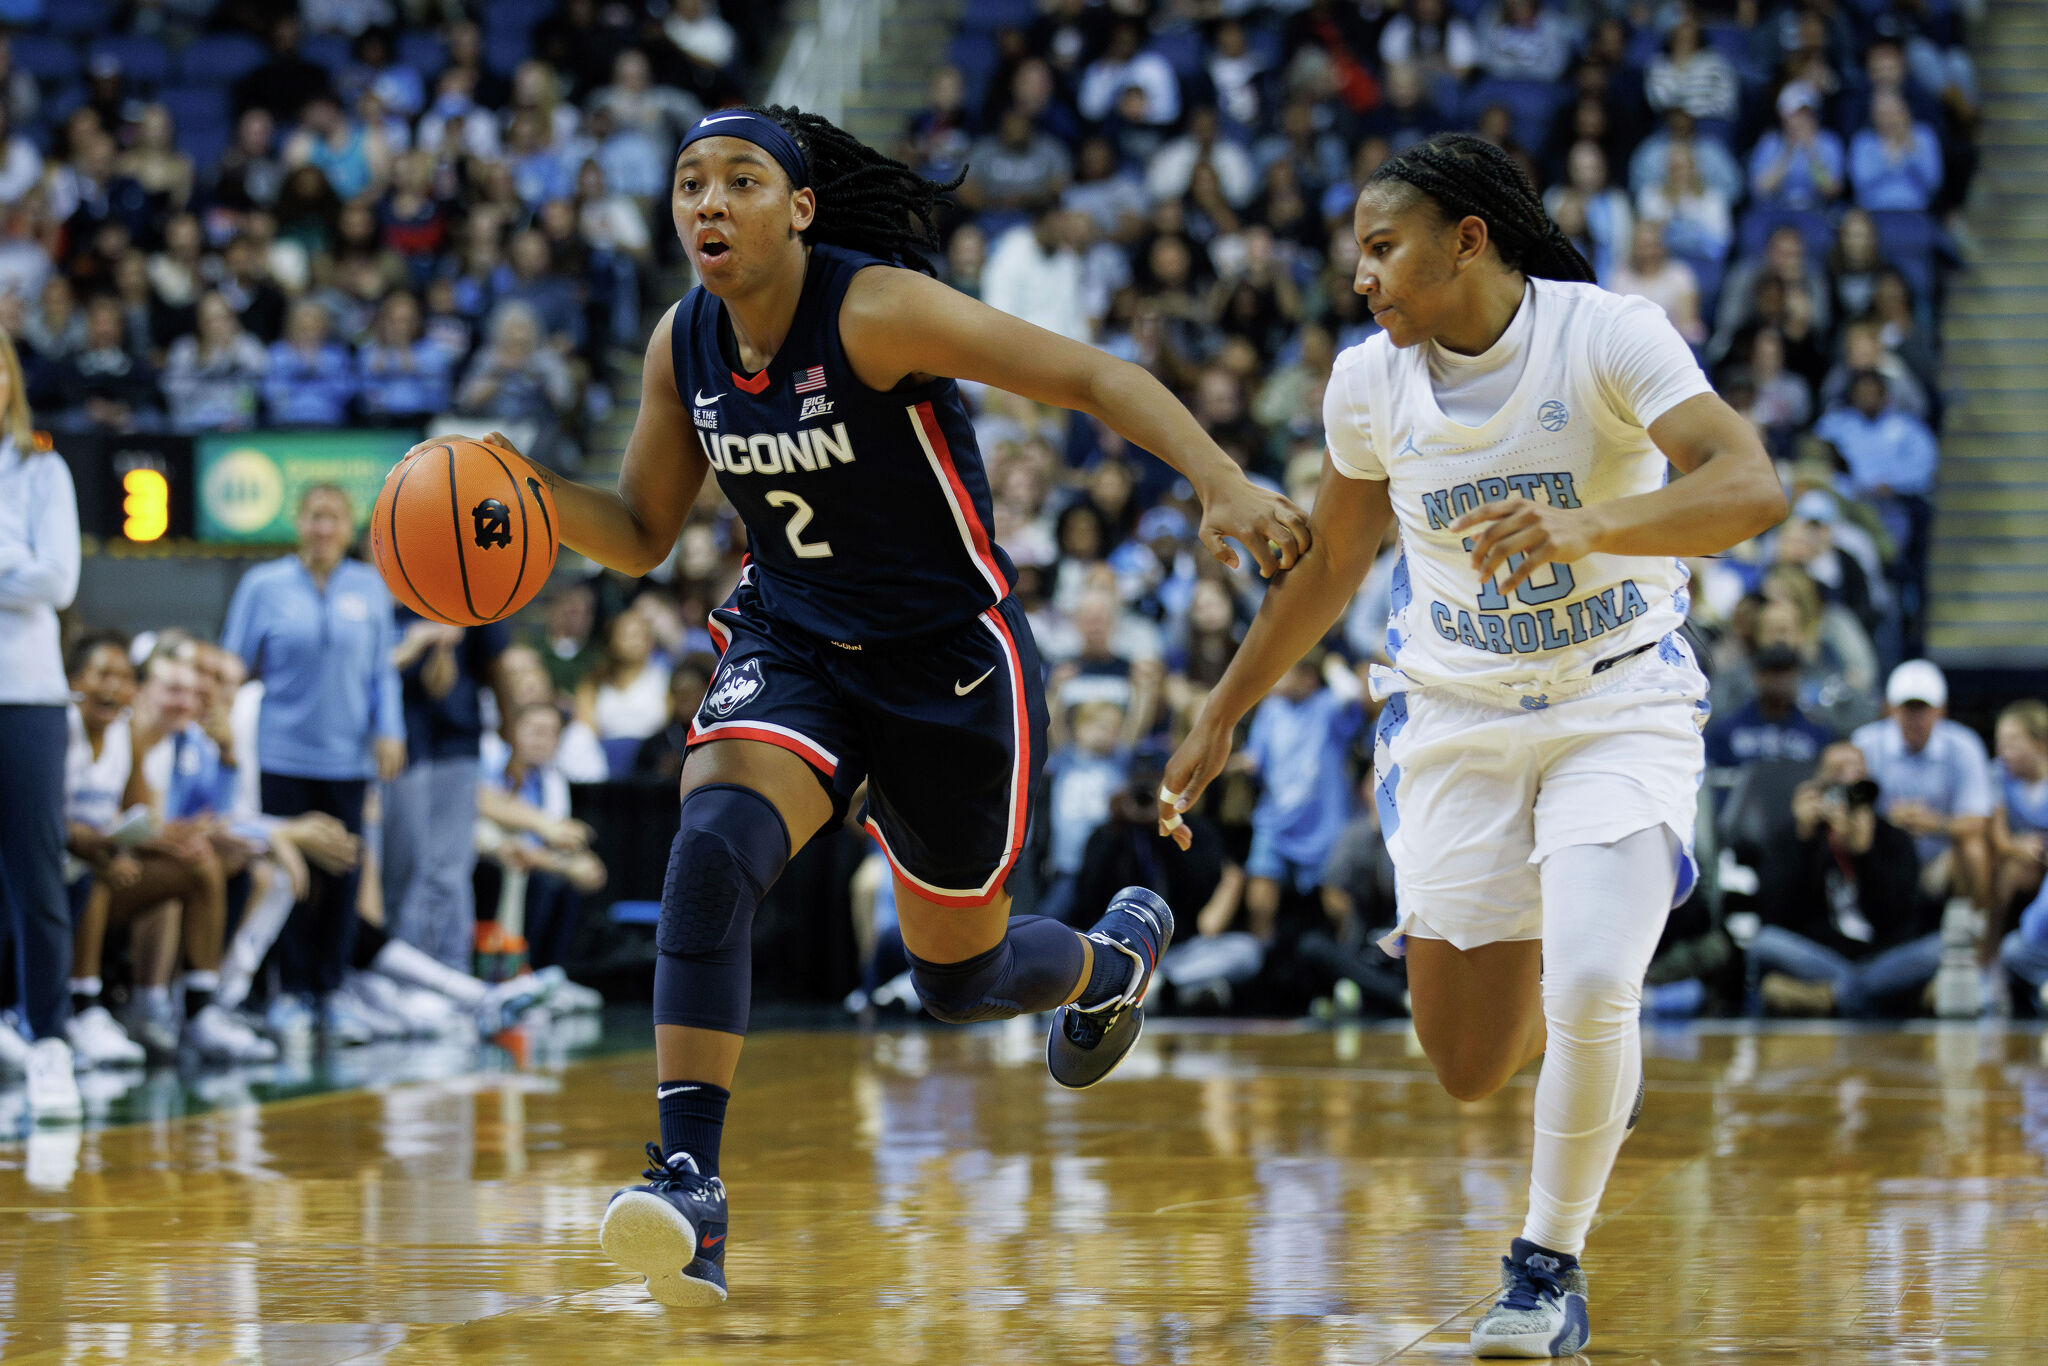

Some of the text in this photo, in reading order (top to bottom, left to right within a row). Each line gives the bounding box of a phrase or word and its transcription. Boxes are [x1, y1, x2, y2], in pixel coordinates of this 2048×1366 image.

[702, 410, 717, 420] THE
[800, 401, 835, 416] EAST
[802, 394, 826, 408] BIG
[693, 419, 718, 429] CHANGE
[697, 422, 856, 475] UCONN
[1421, 472, 1583, 530] NORTH
[764, 489, 834, 559] 2
[1430, 579, 1648, 654] CAROLINA
